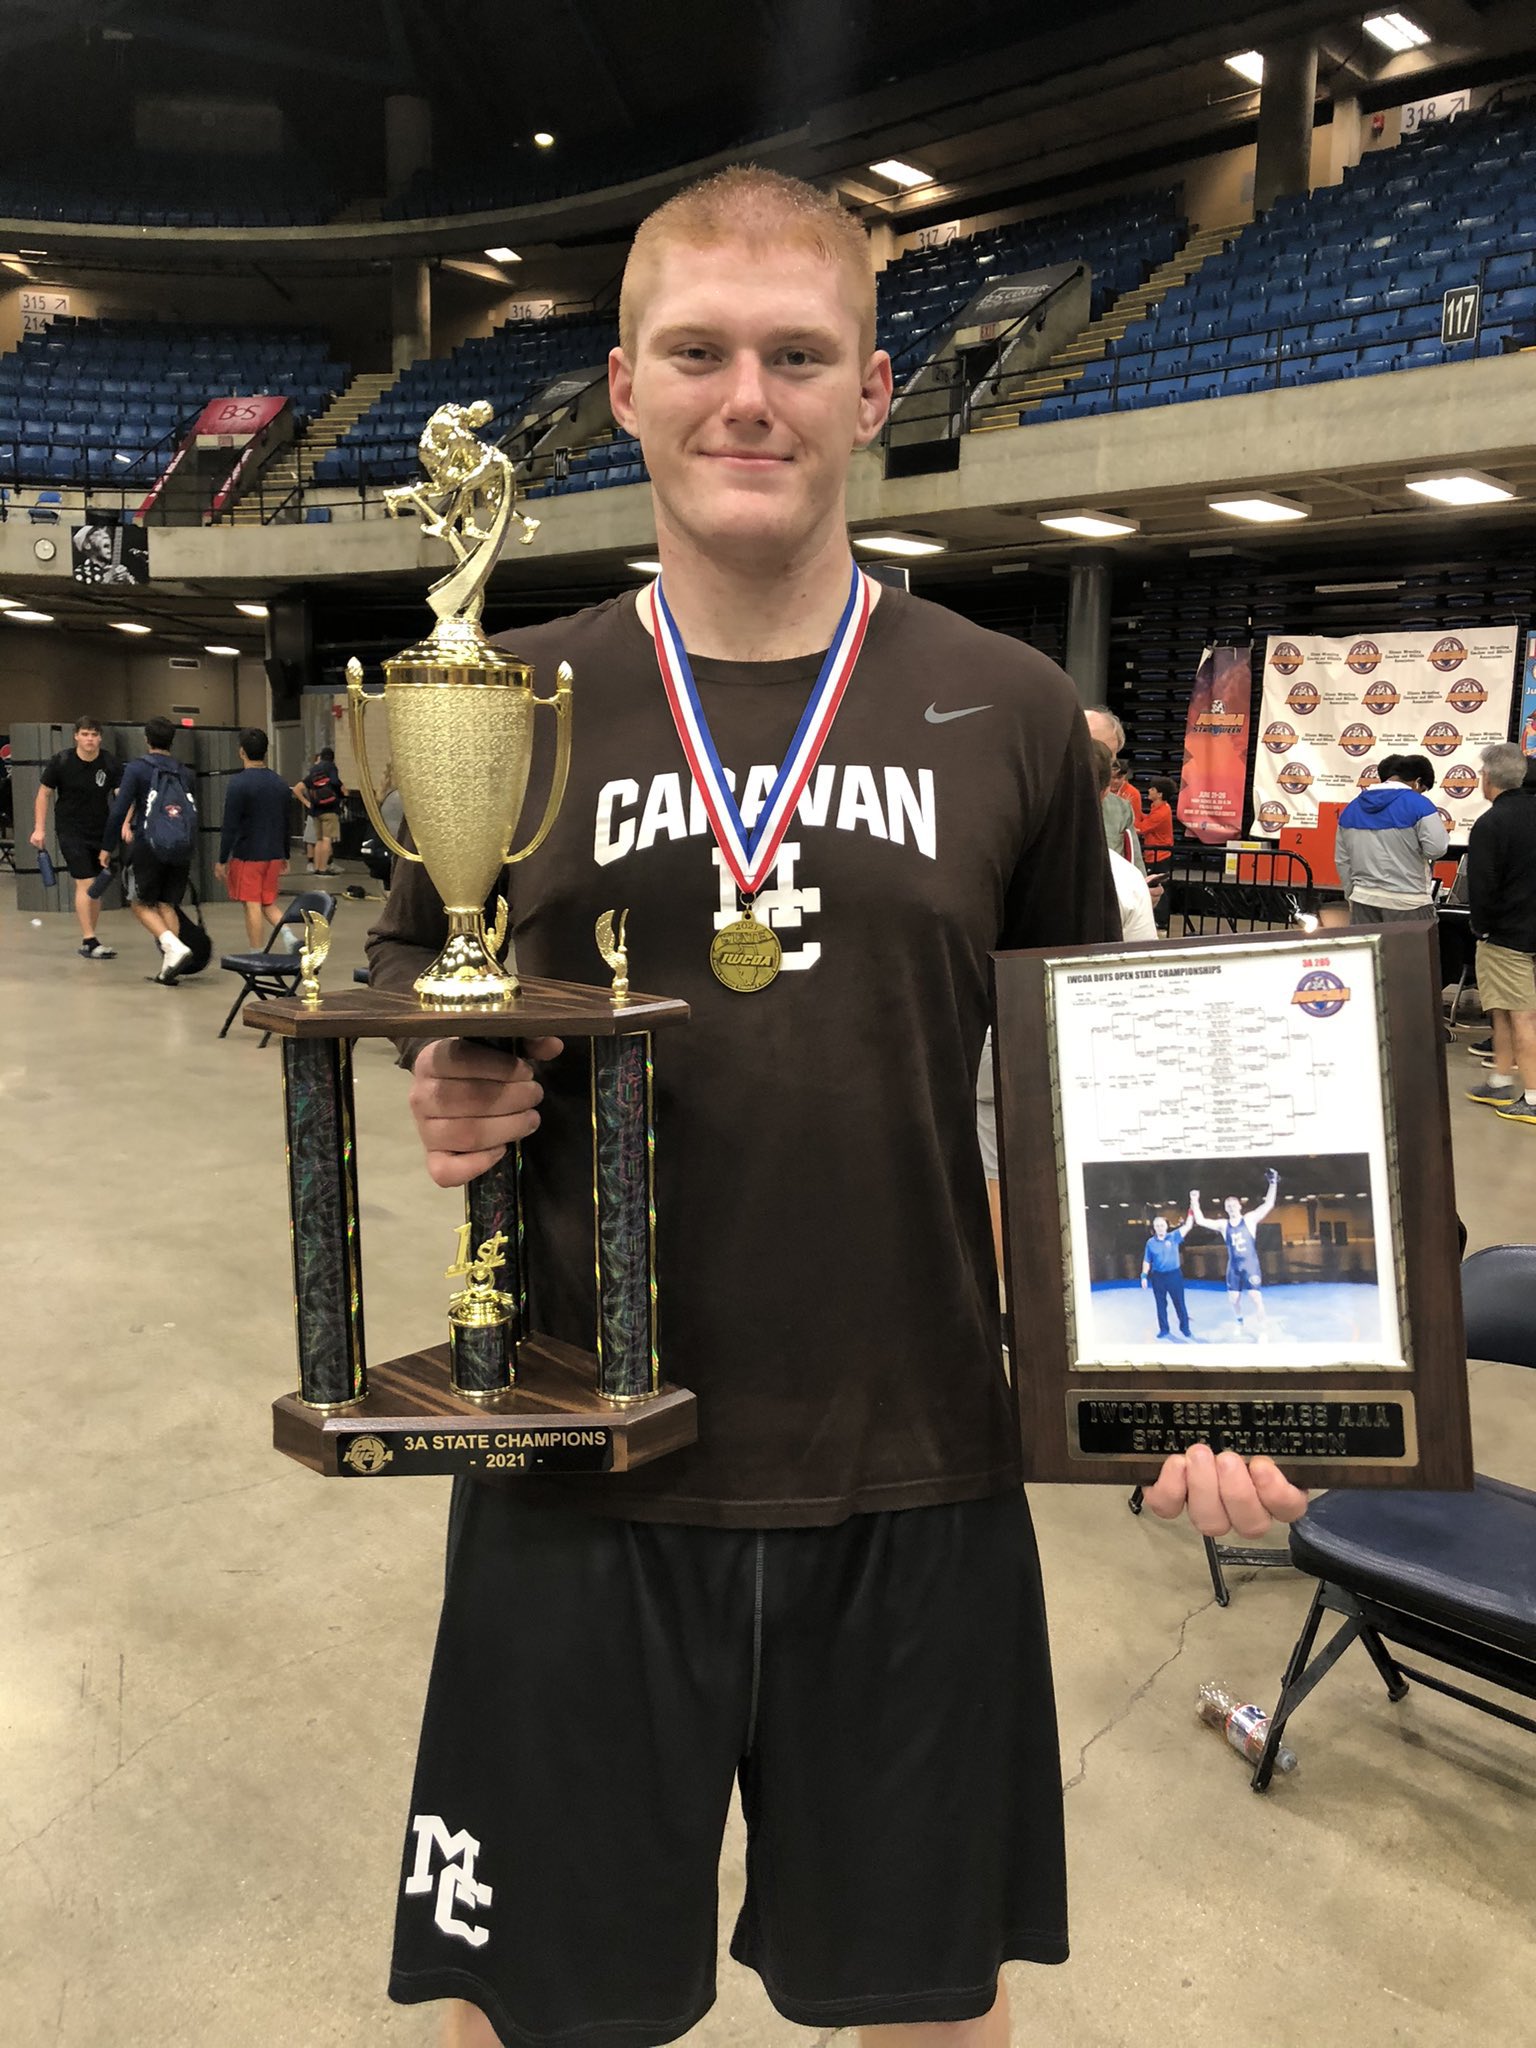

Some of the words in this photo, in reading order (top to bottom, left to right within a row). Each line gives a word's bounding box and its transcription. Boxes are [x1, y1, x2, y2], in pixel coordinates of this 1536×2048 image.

[1406, 102, 1436, 129] 318
[918, 229, 939, 243] 317
[22, 294, 47, 311] 315
[511, 304, 532, 318] 316
[1447, 294, 1476, 336] 117
[1295, 832, 1303, 845] 2
[735, 921, 759, 931] 2021
[719, 952, 773, 967] IWCOA
[1067, 974, 1093, 985] IWCOA
[1094, 972, 1114, 983] BOYS
[1114, 970, 1134, 981] OPEN
[1135, 969, 1157, 980] STATE
[1158, 965, 1222, 978] CHAMPIONSHIPS
[1089, 1402, 1164, 1424] IWCOA
[1252, 1403, 1329, 1427] CLASS
[1338, 1404, 1391, 1428] AAA
[404, 1435, 428, 1451] 3A
[432, 1434, 490, 1450] STATE
[494, 1430, 607, 1449] CHAMPIONS
[1132, 1429, 1211, 1452] STATE
[1217, 1430, 1348, 1455] CHAMPION
[485, 1453, 526, 1468] 2021
[404, 1814, 494, 1947] MC
